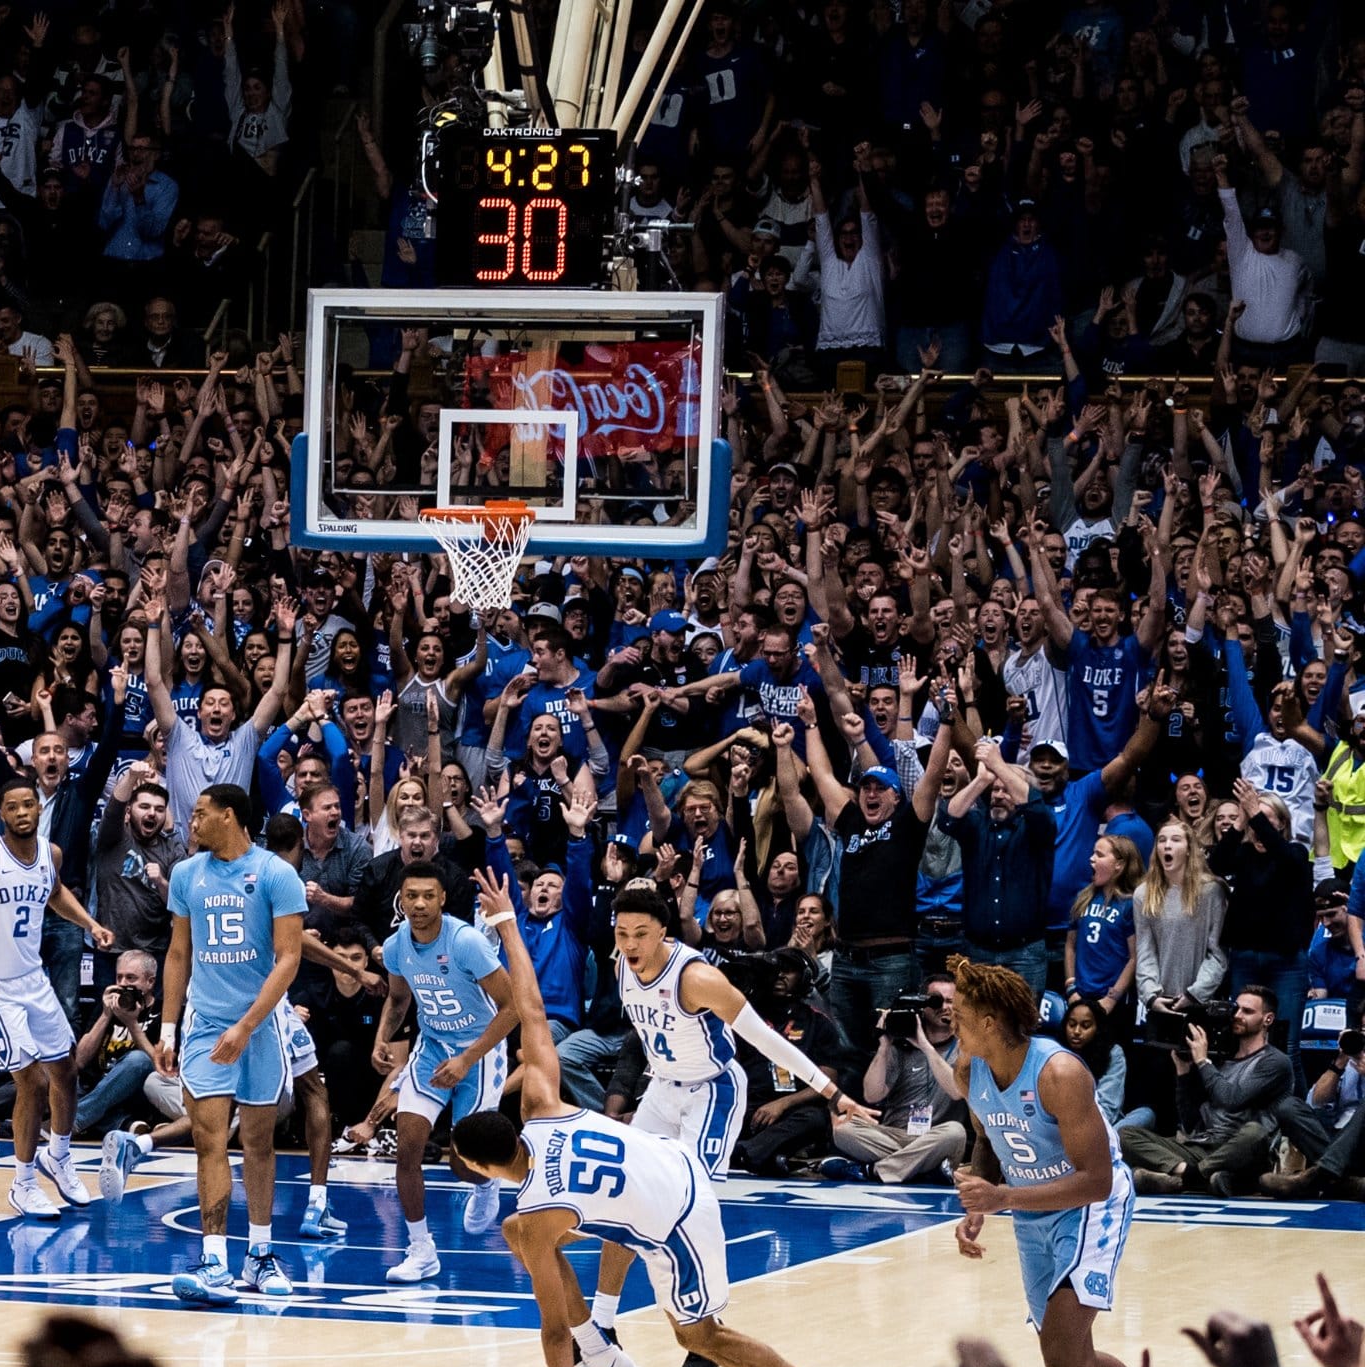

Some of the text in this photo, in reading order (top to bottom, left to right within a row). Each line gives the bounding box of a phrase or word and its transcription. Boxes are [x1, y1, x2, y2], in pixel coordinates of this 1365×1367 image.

[483, 127, 563, 137] DAKTRONICS
[486, 144, 590, 191] 4:27
[476, 198, 567, 280] 30
[318, 523, 357, 534] SPALDING
[1084, 666, 1123, 686] DUKE
[172, 697, 201, 712] DUK
[759, 682, 808, 703] CAMERO
[1092, 691, 1109, 717] 5
[1263, 766, 1295, 793] 15
[204, 894, 246, 909] NORTH
[13, 905, 30, 939] 2
[207, 912, 246, 947] 15
[1087, 921, 1102, 943] 3
[198, 949, 259, 965] CAROLINA
[412, 974, 448, 998] NORTH
[416, 988, 463, 1017] 55
[422, 1012, 477, 1032] CAROLINA
[987, 1111, 1031, 1134] NORTH
[1001, 1131, 1036, 1165] 5
[546, 1129, 570, 1198] ROBINSON
[568, 1129, 626, 1199] 50
